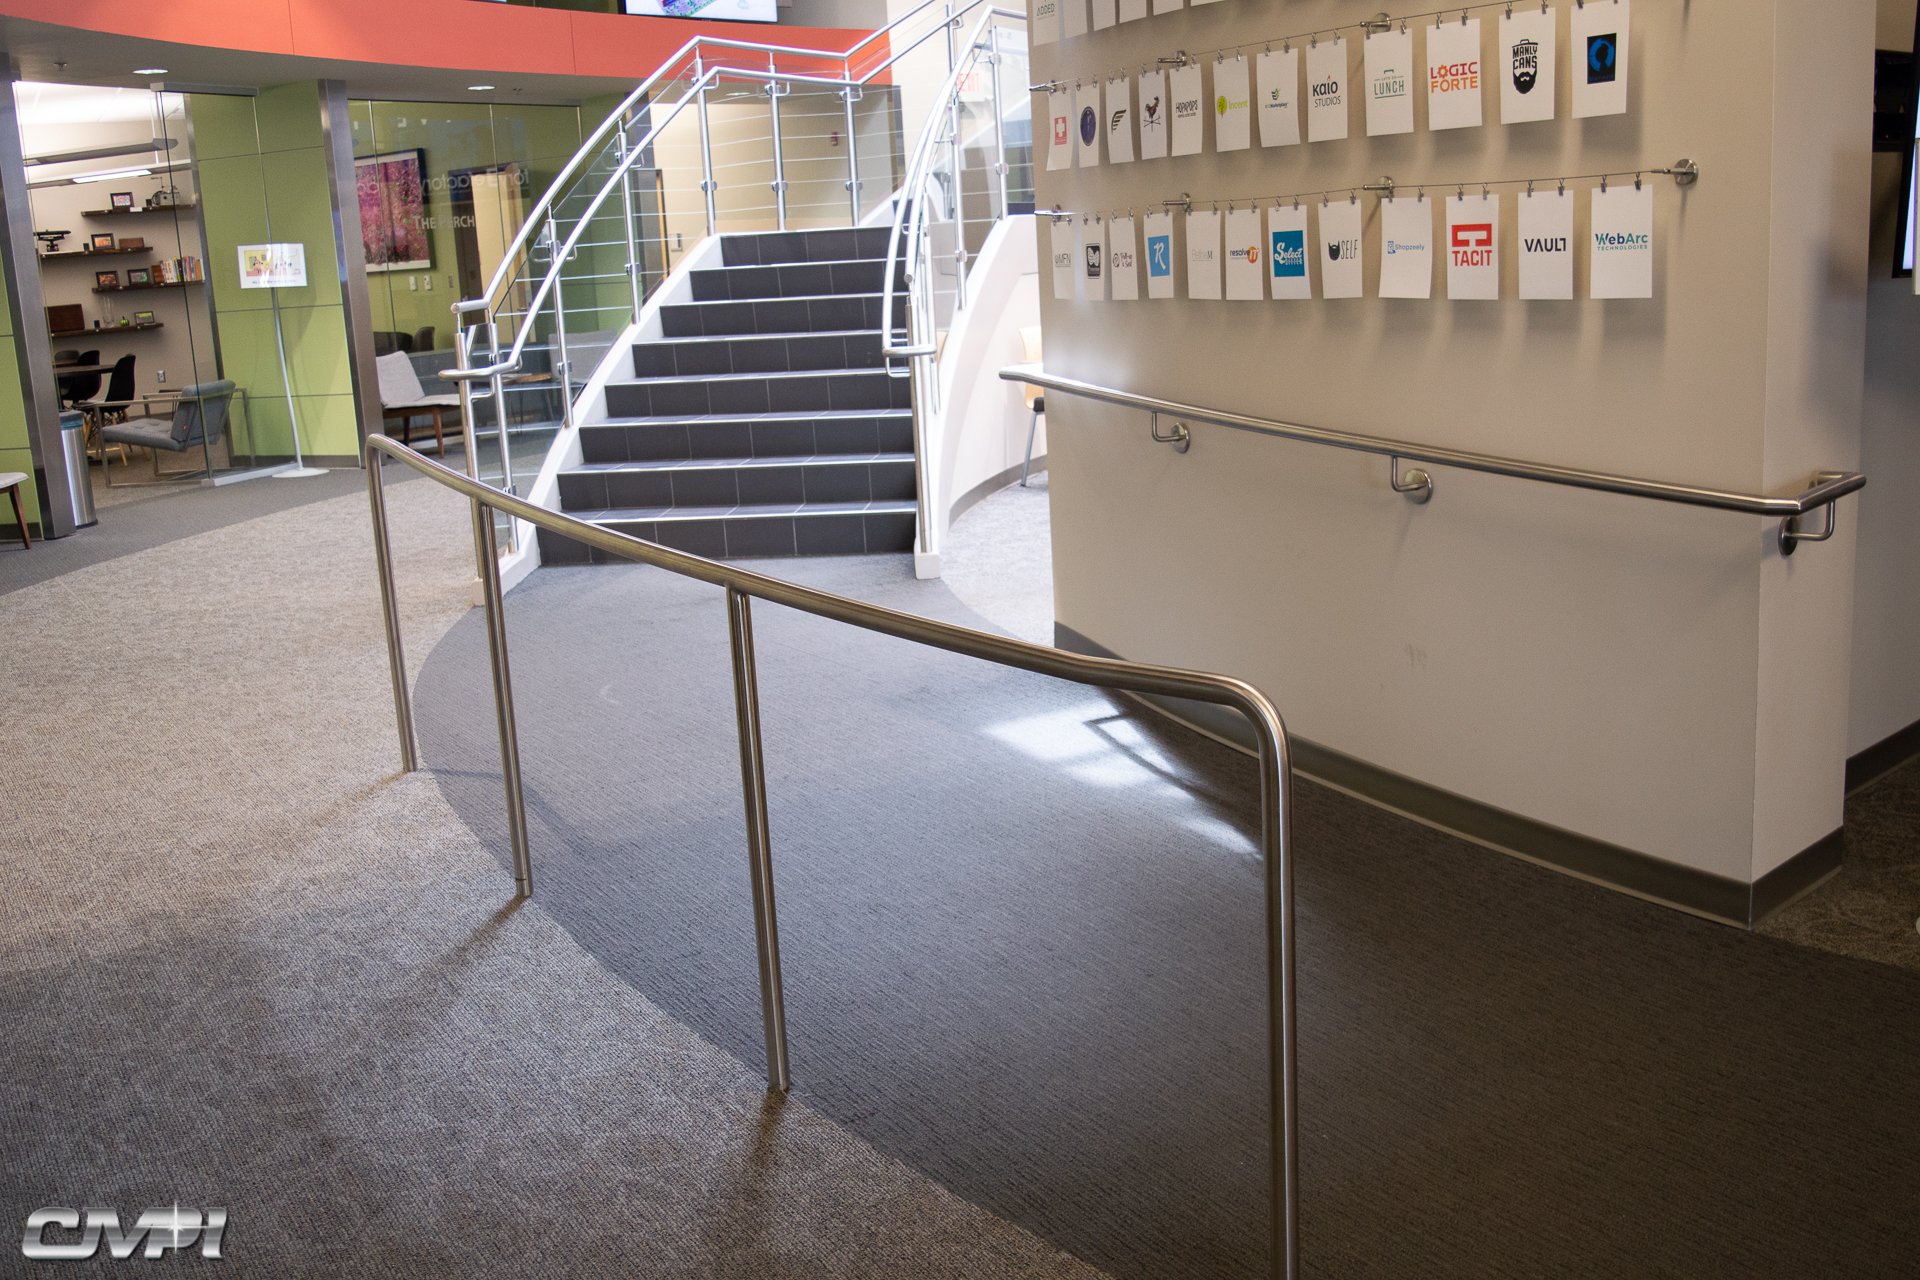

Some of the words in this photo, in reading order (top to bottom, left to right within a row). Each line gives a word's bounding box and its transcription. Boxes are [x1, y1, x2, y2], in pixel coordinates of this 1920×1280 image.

[1513, 46, 1537, 59] MANLY
[1430, 62, 1478, 79] LOGIC
[1513, 56, 1537, 70] CANS
[1374, 80, 1404, 95] LUNCH
[1431, 76, 1478, 93] FORTE
[1314, 96, 1341, 108] STUDIOS
[413, 215, 437, 230] THE
[1524, 238, 1566, 252] VAULT
[1595, 233, 1648, 245] WebArc
[1274, 241, 1303, 265] Select
[1341, 239, 1358, 260] SELF
[1452, 250, 1492, 266] TACIT
